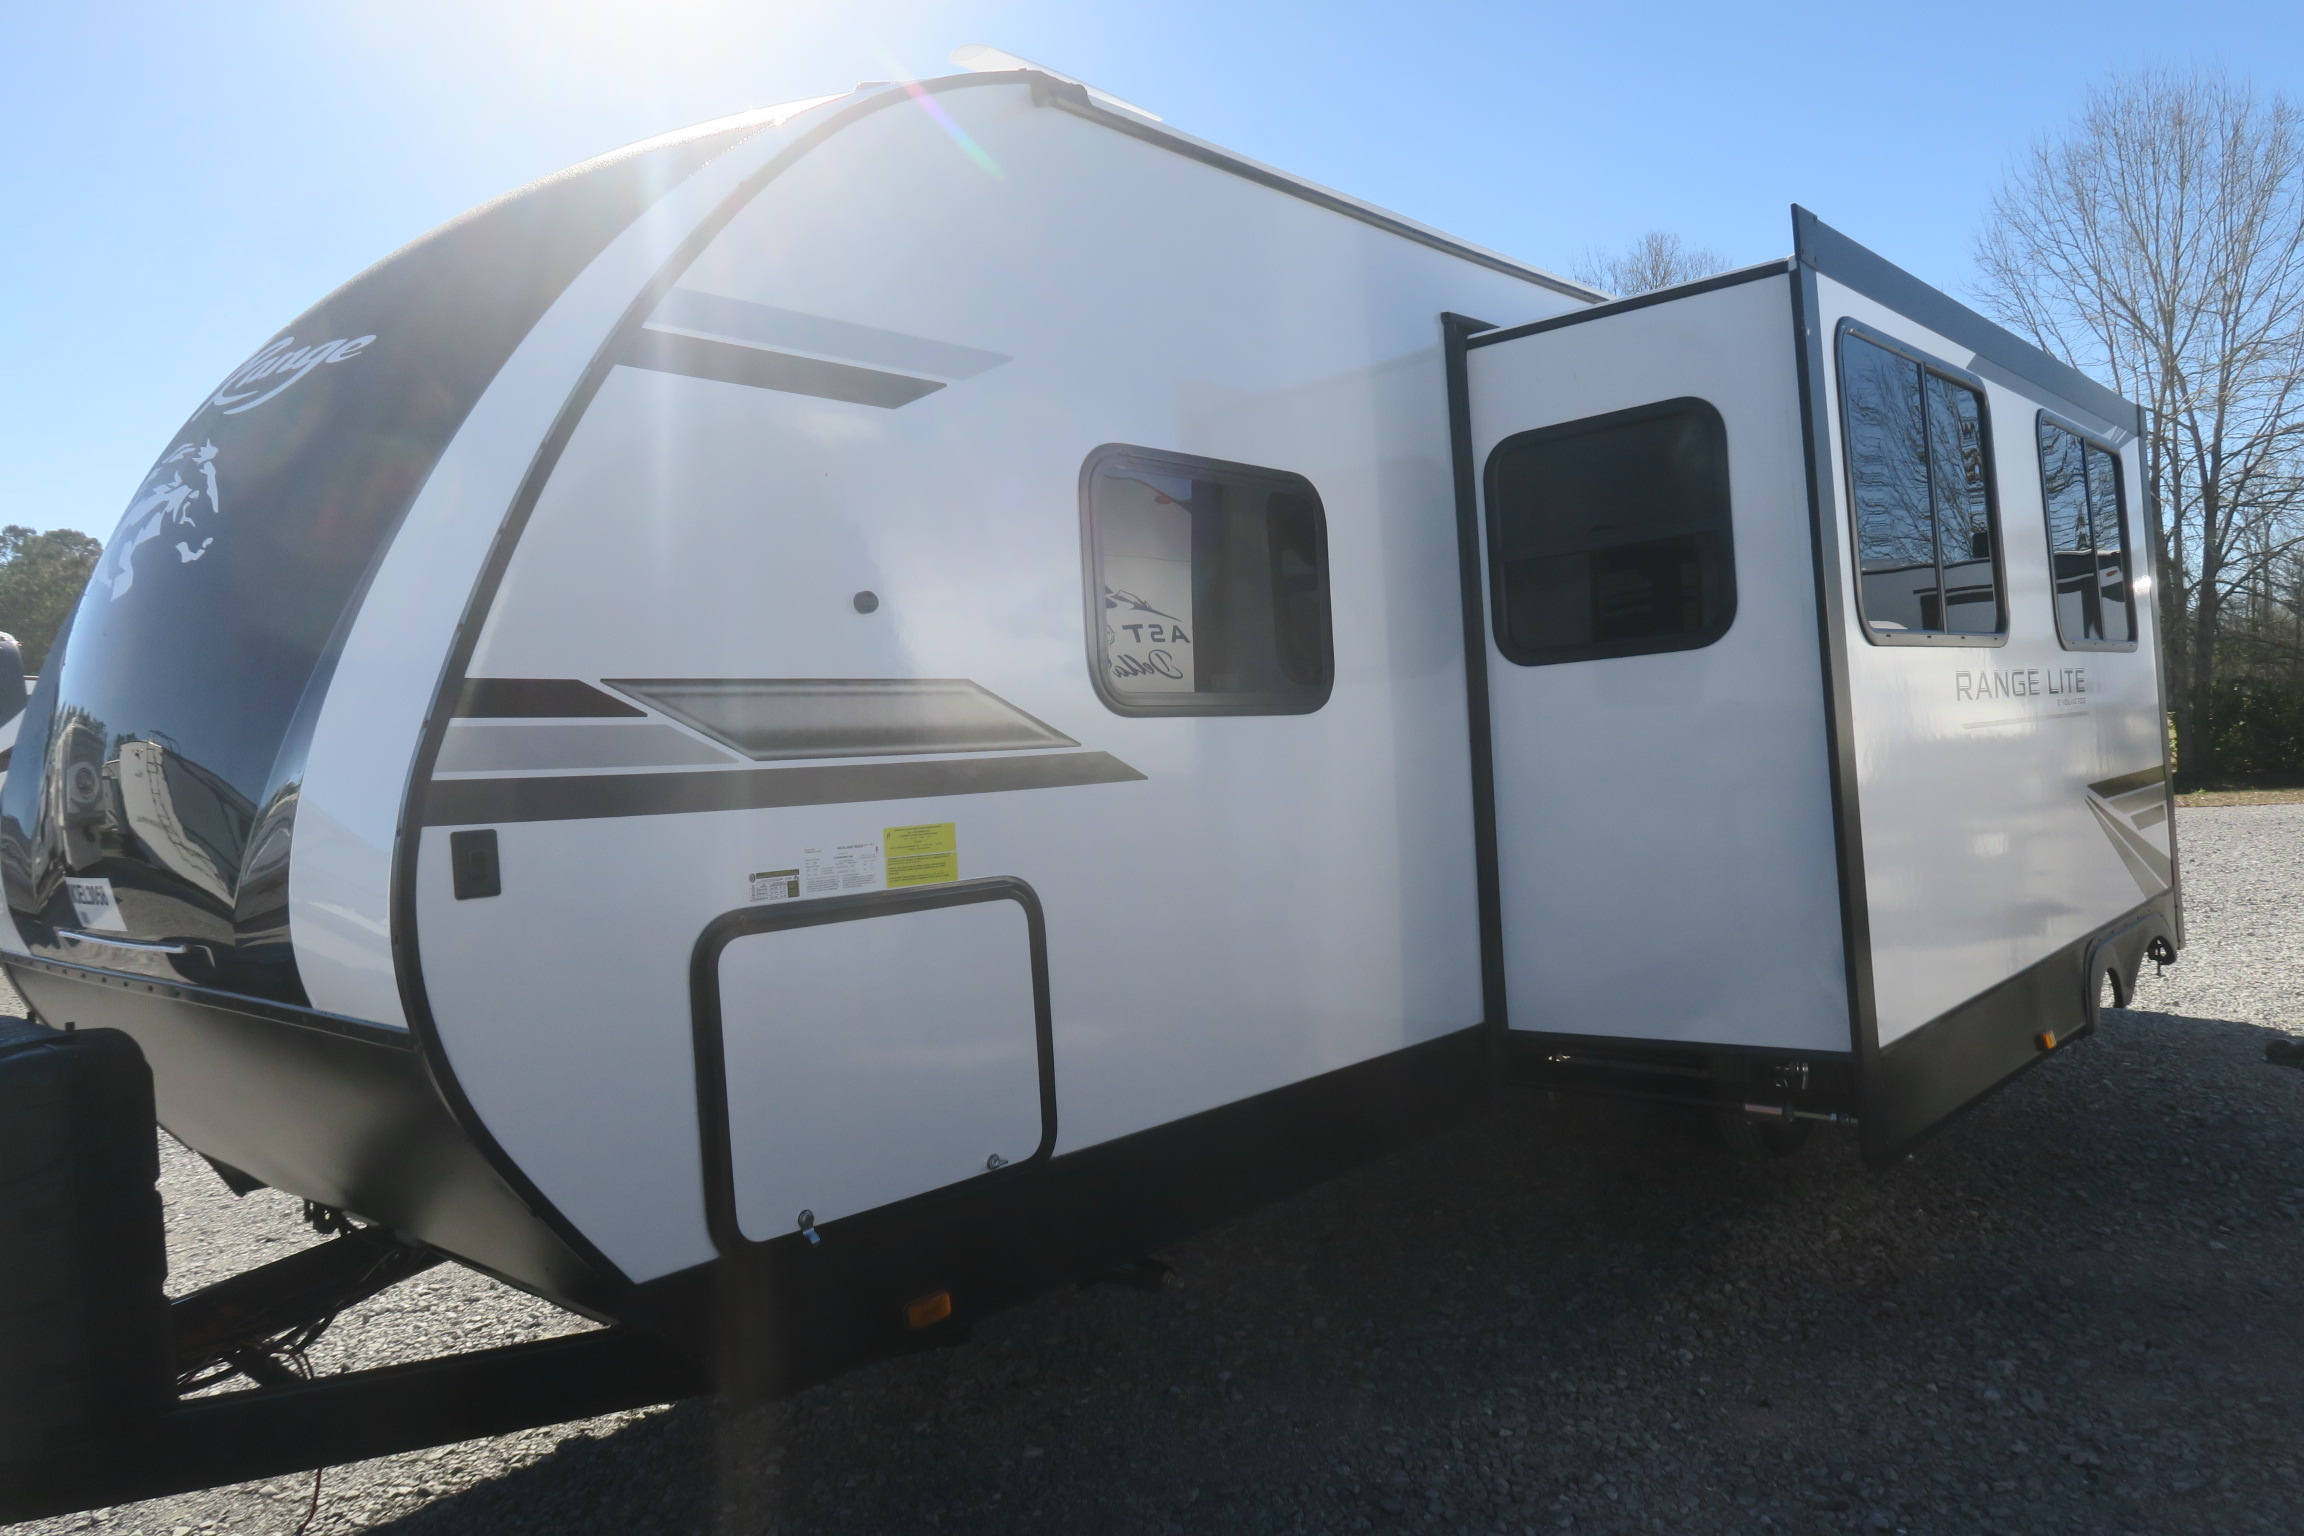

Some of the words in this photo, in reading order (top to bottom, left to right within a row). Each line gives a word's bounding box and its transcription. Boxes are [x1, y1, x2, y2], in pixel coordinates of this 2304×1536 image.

[191, 334, 376, 422] Range
[1955, 668, 2040, 701] RANGE
[2046, 667, 2086, 695] LITE
